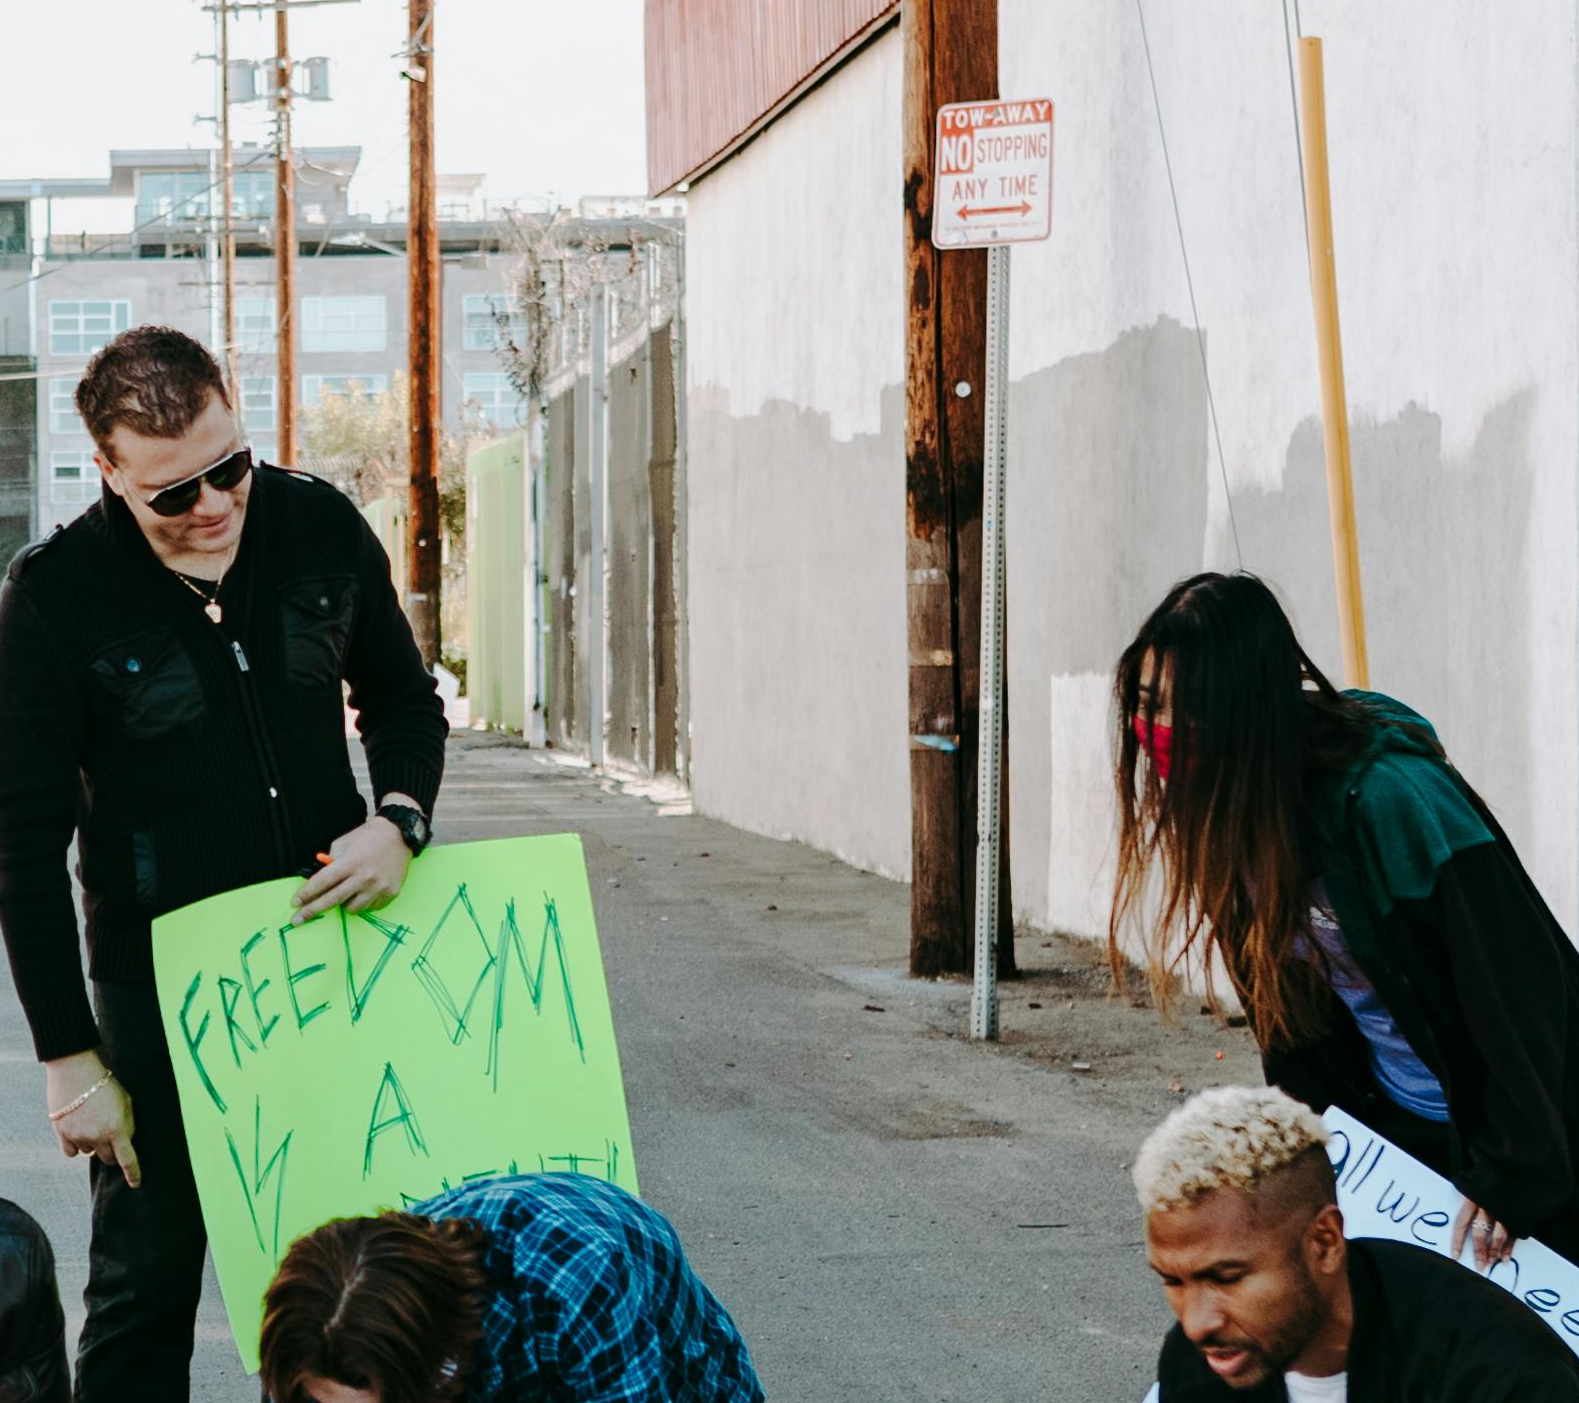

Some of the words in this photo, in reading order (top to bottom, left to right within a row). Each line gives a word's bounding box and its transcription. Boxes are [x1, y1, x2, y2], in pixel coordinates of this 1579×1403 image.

[943, 101, 1050, 130] TOW-AWAY
[940, 133, 972, 173] NO
[976, 132, 1048, 164] STOPPING
[952, 177, 988, 201] ANY
[998, 173, 1039, 198] TIME
[178, 882, 587, 1114] FREEDOM
[362, 1061, 431, 1182] A
[1375, 1179, 1450, 1246] we
